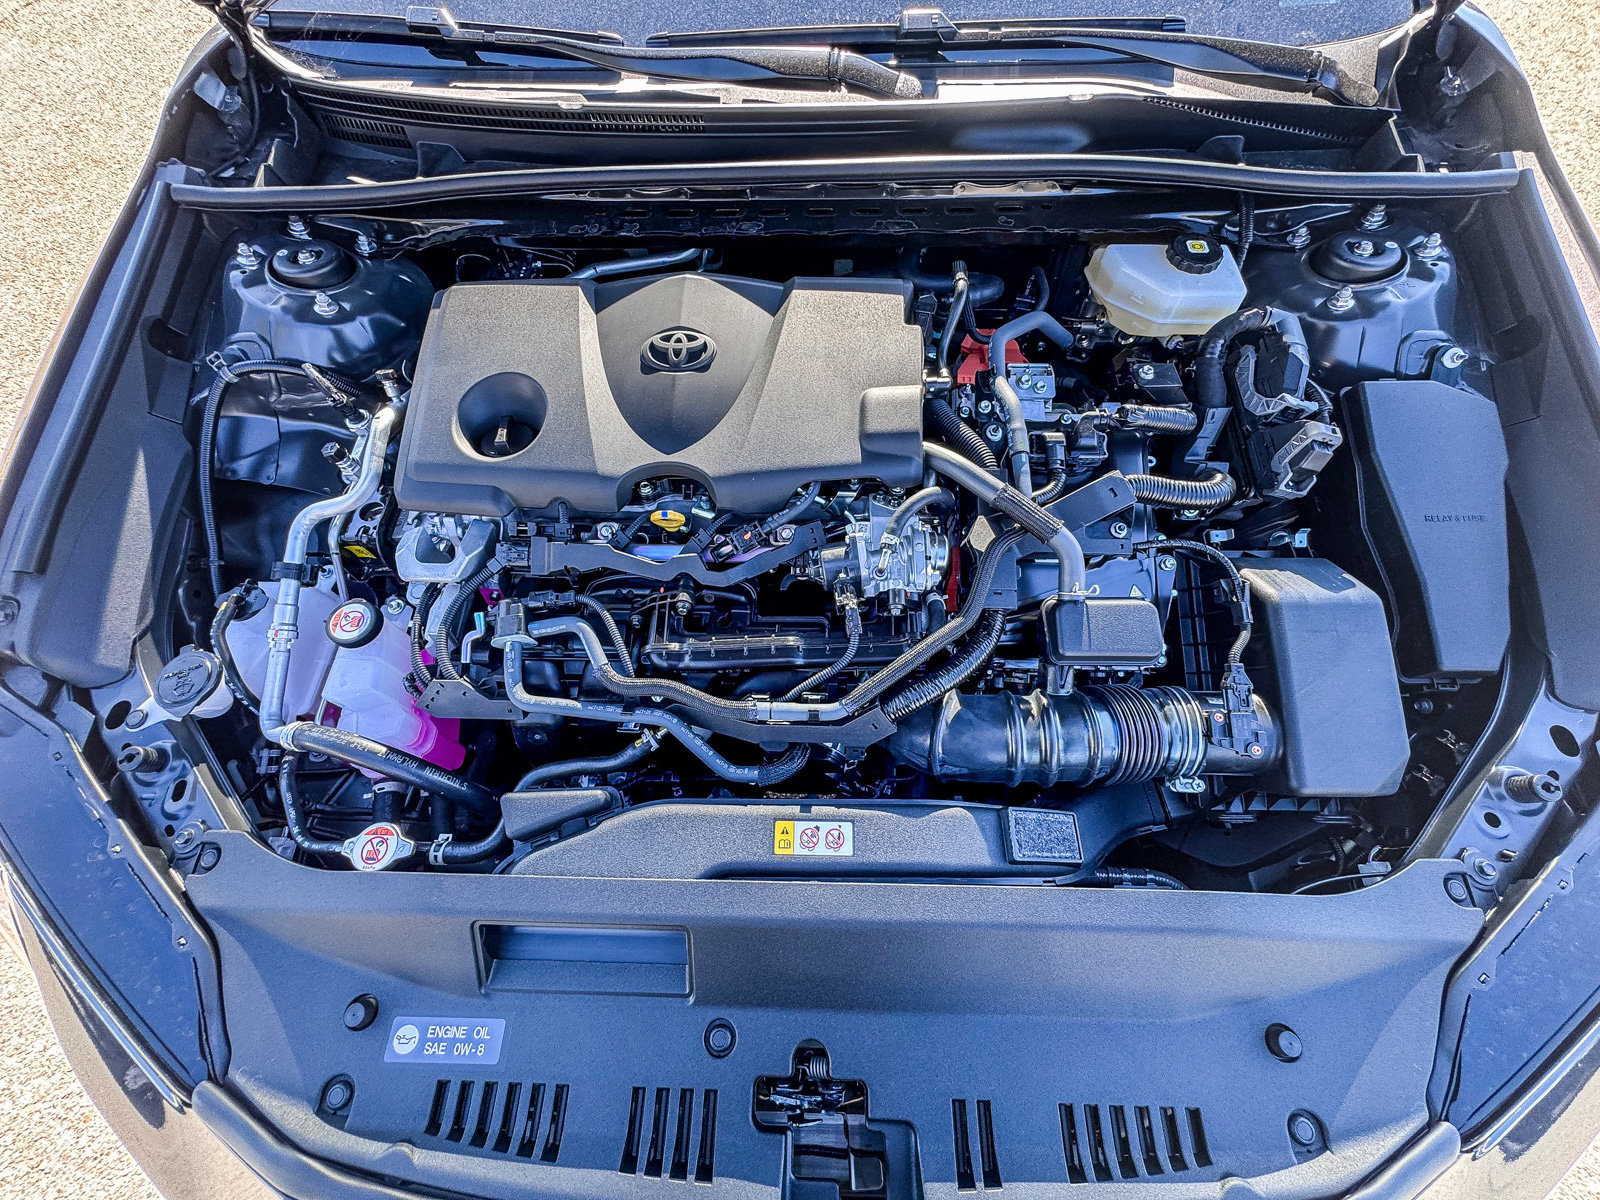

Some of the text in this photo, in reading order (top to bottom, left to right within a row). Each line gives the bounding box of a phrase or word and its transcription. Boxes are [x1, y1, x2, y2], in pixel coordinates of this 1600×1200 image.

[1424, 514, 1452, 522] RELAY
[427, 1025, 491, 1039] ENGINE OIL
[423, 1041, 485, 1056] SAE 0W-8
